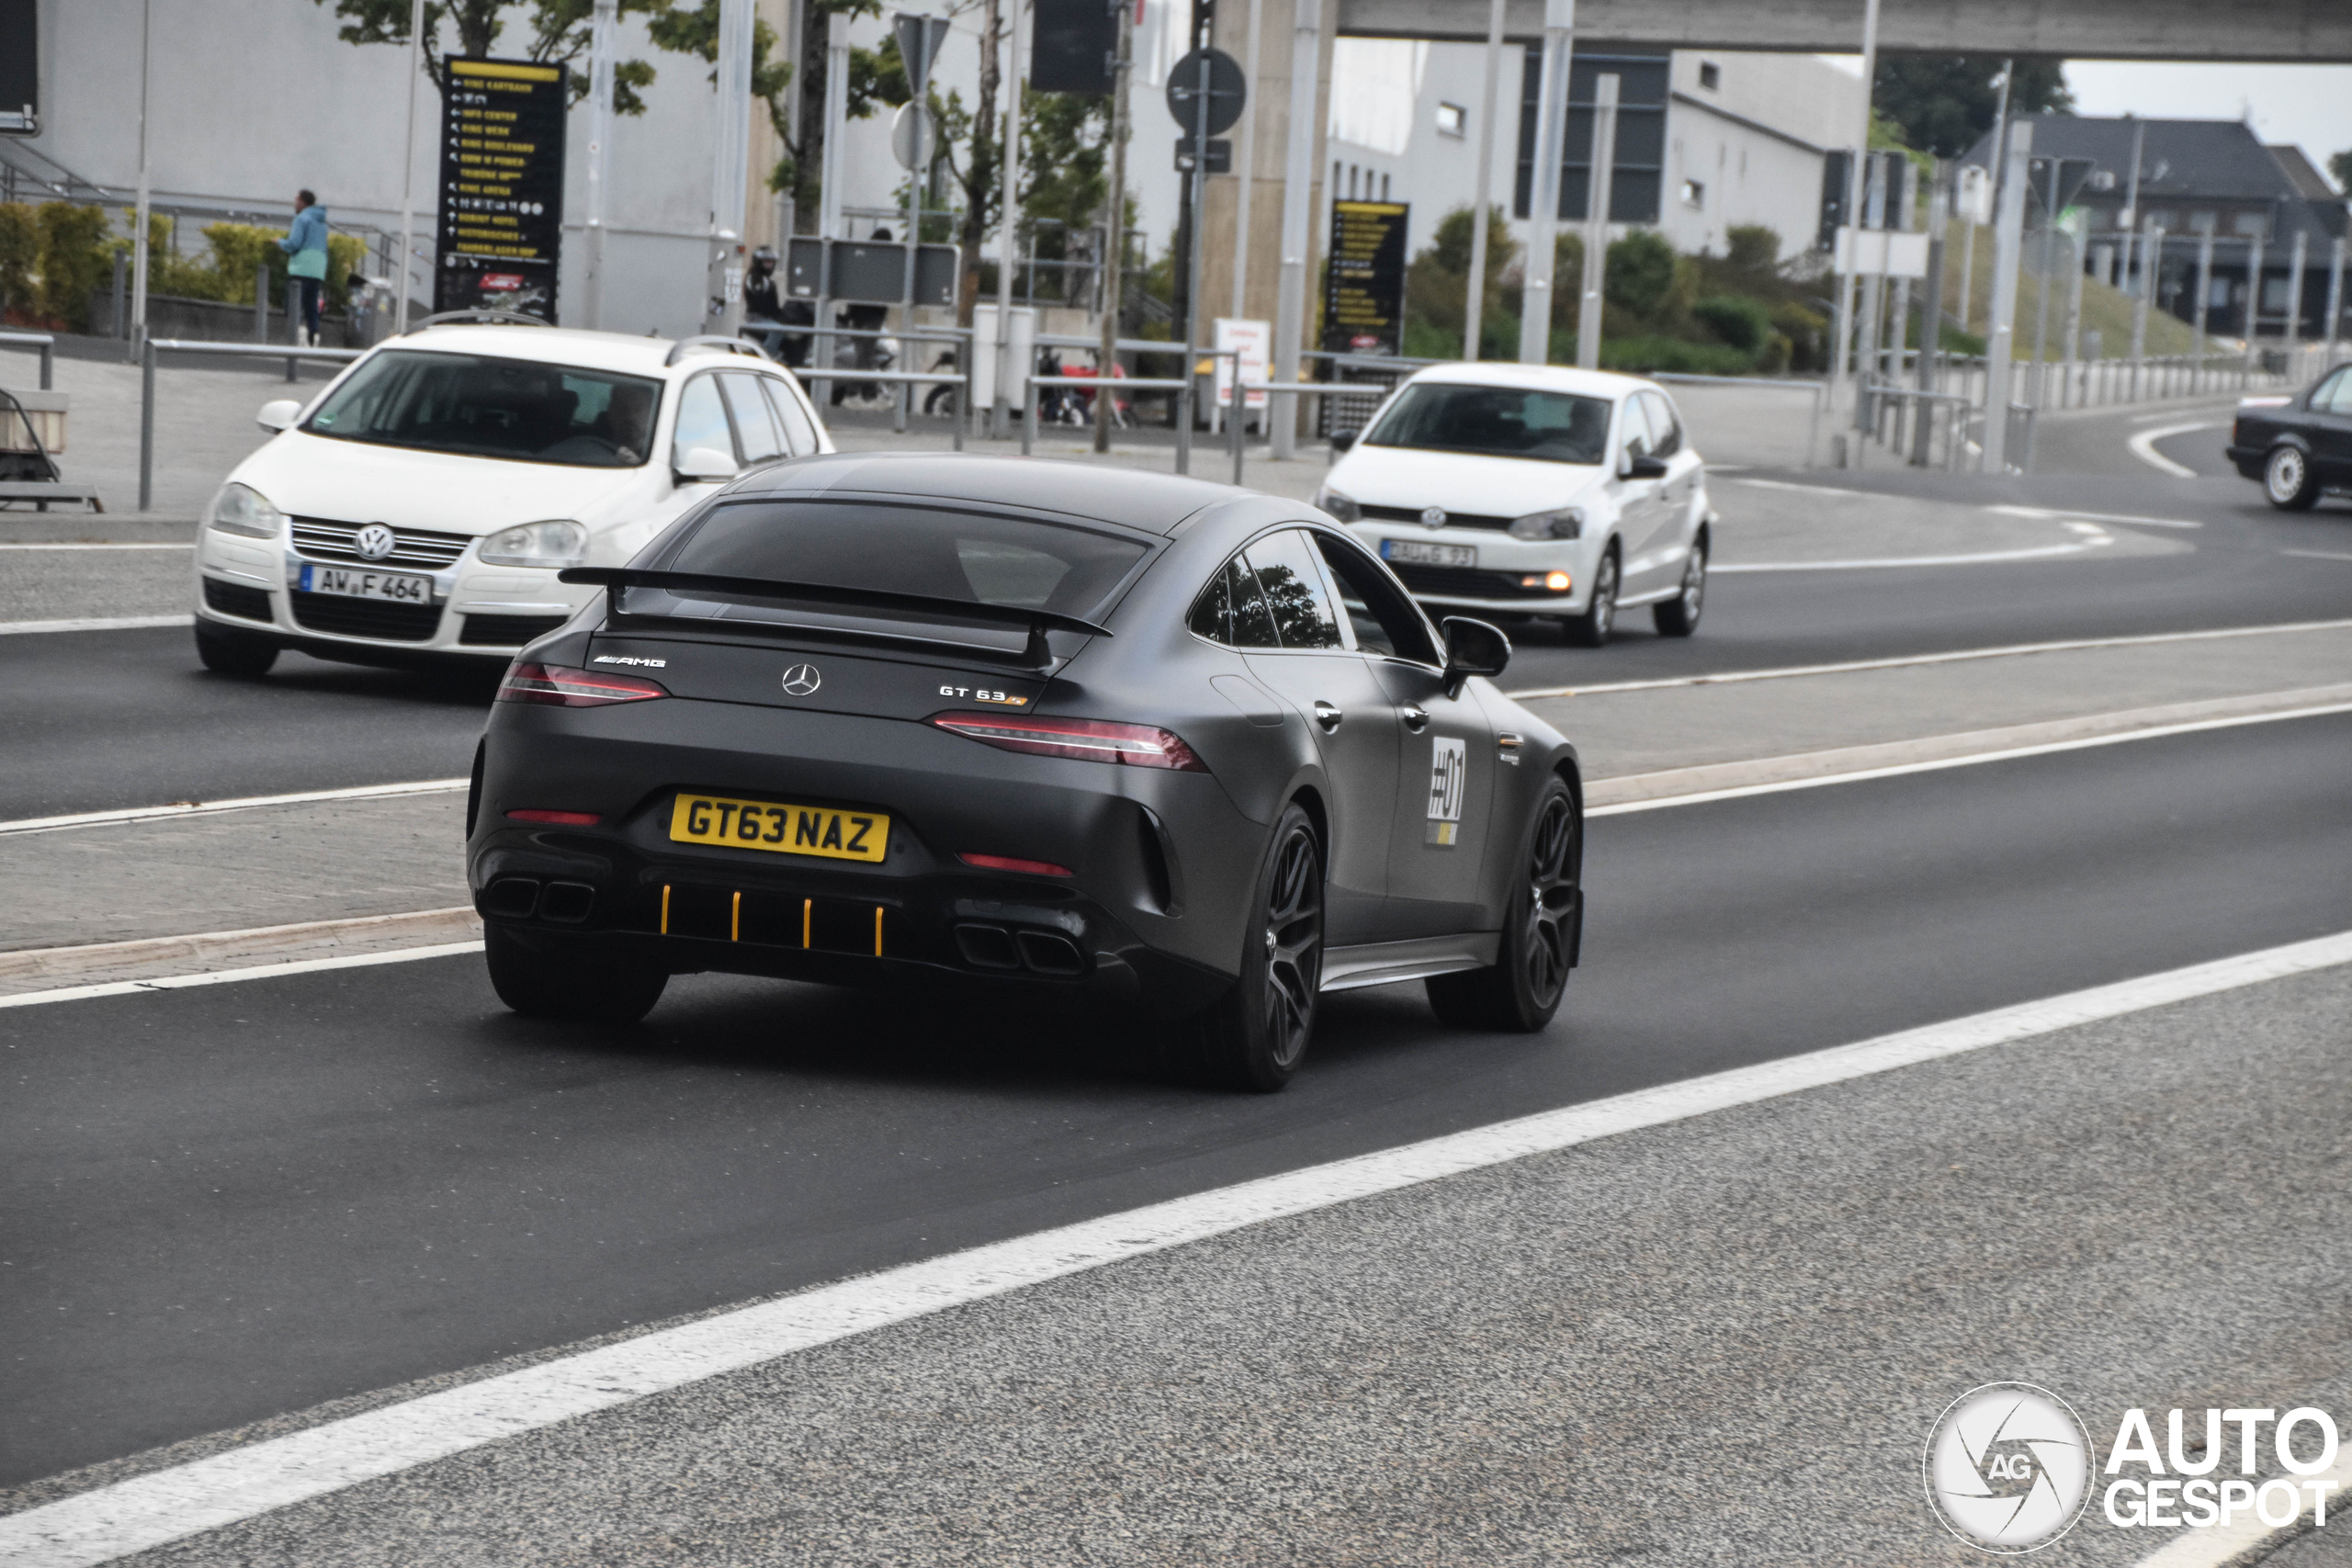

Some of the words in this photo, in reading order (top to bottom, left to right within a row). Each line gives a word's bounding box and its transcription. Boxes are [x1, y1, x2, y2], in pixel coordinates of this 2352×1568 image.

[616, 657, 667, 669] AMG
[939, 685, 970, 698] GT
[687, 799, 788, 844] GT63
[795, 810, 874, 853] NAZ
